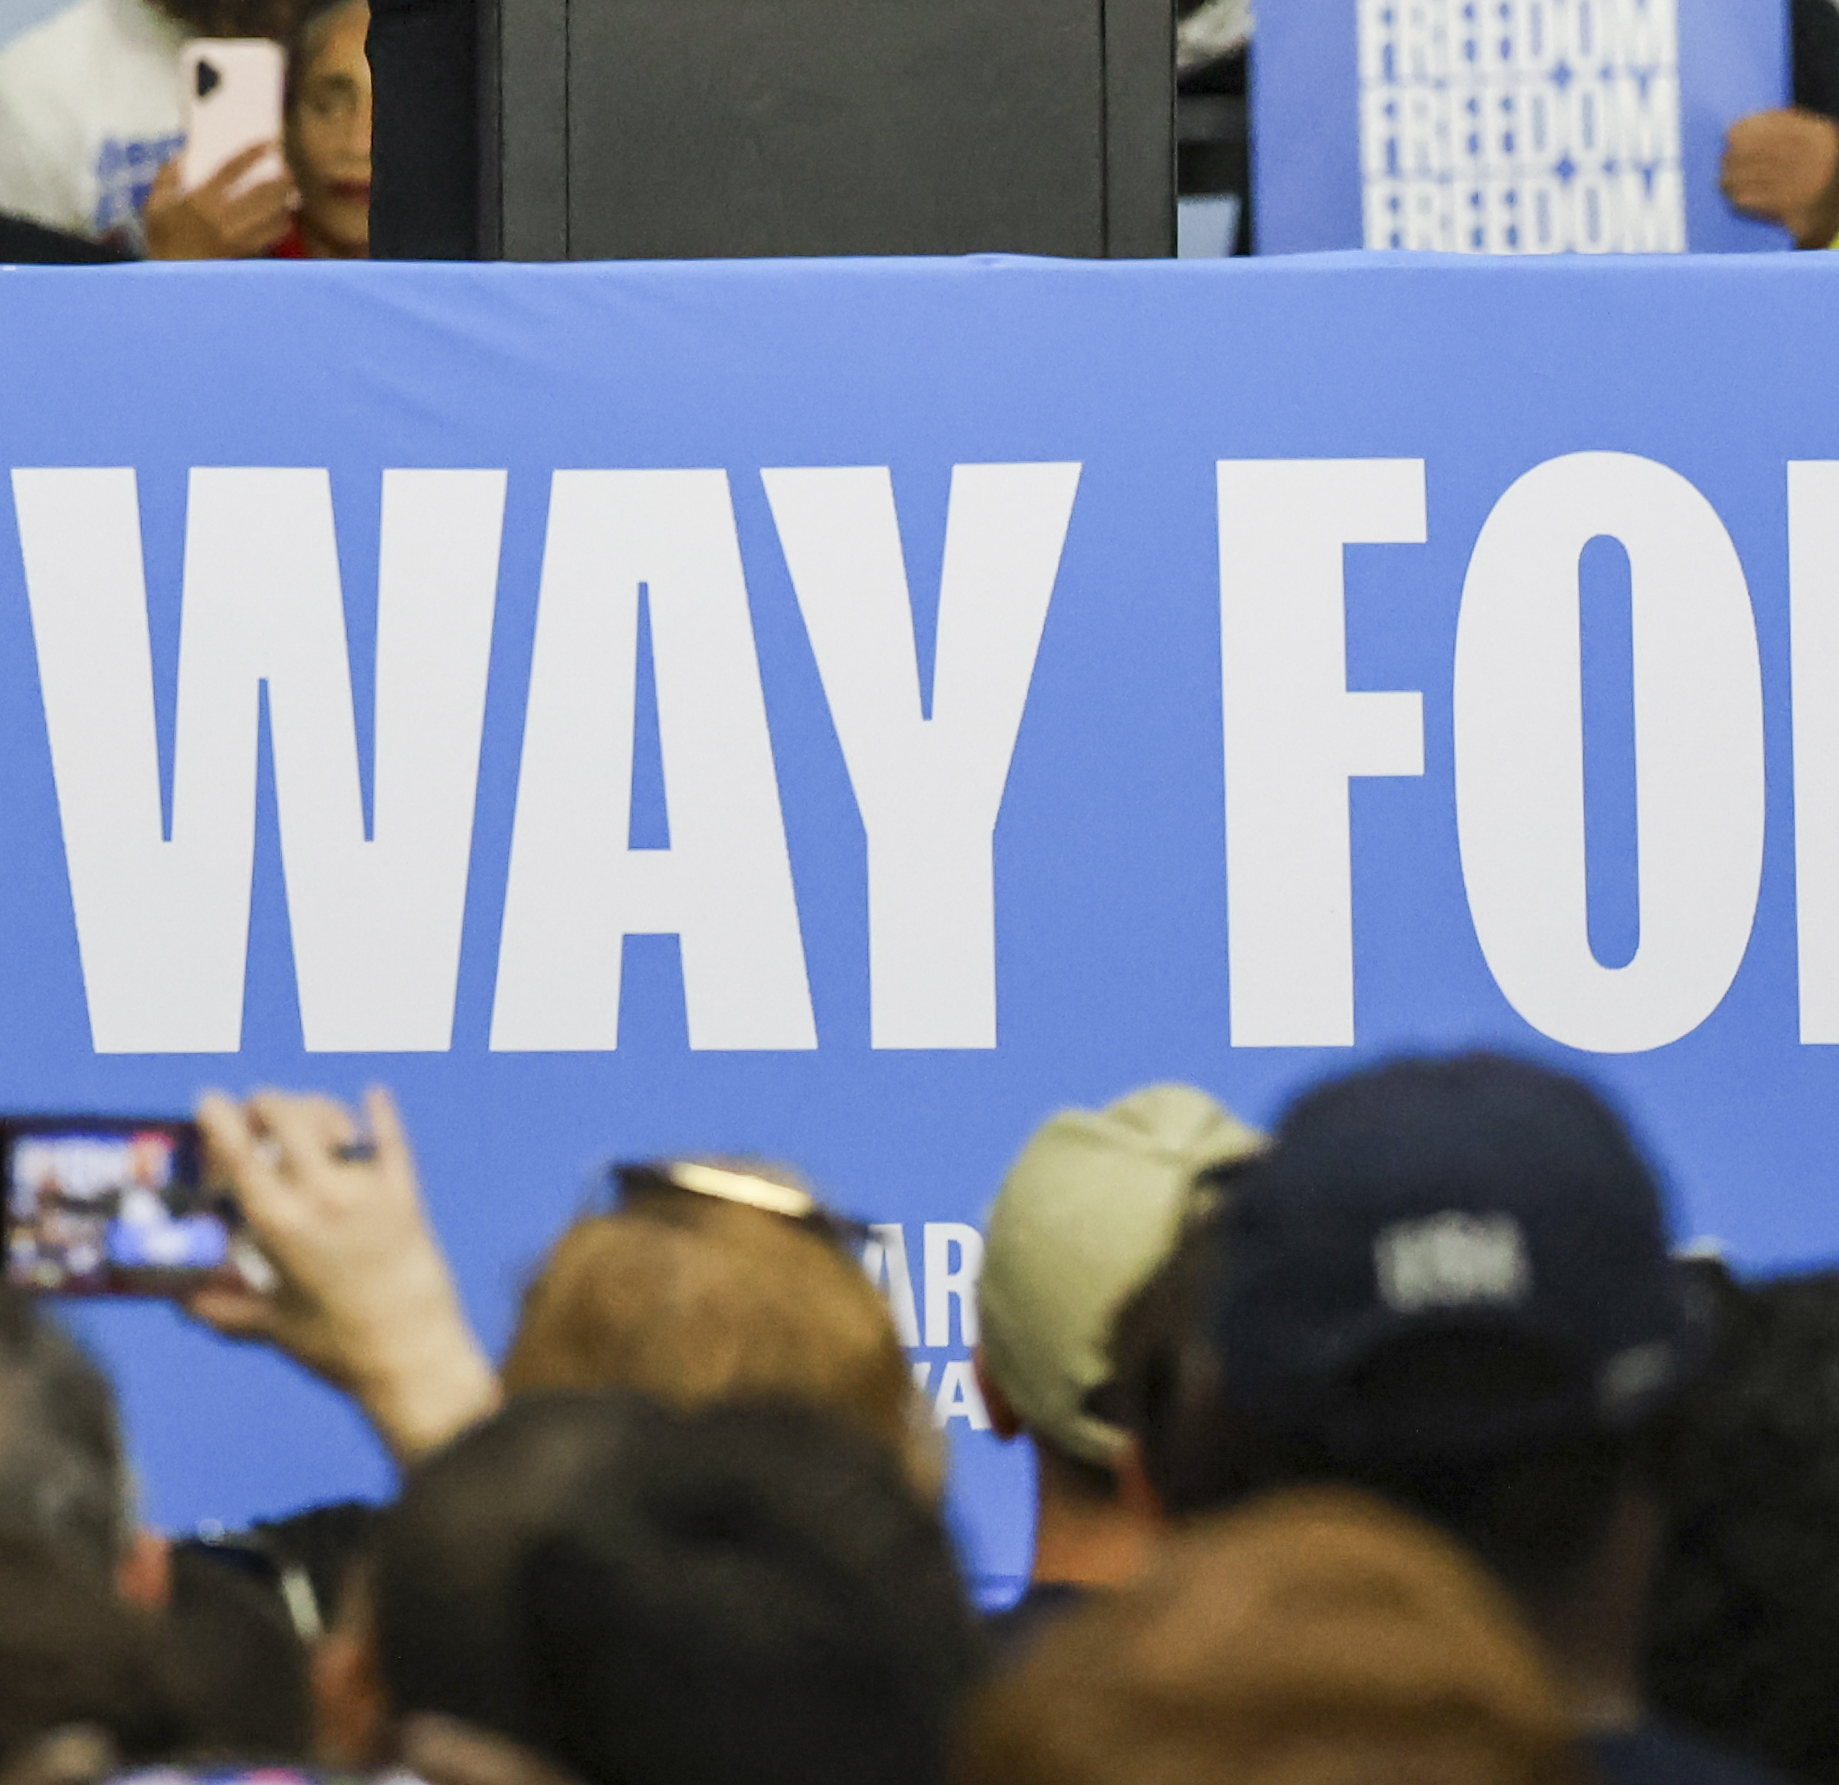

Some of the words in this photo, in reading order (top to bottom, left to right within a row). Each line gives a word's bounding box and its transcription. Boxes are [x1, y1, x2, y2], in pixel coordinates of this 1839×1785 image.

[1360, 68, 1683, 176] FREEDOM
[1363, 160, 1689, 254] FREEDOM
[10, 459, 1082, 1055] WAY
